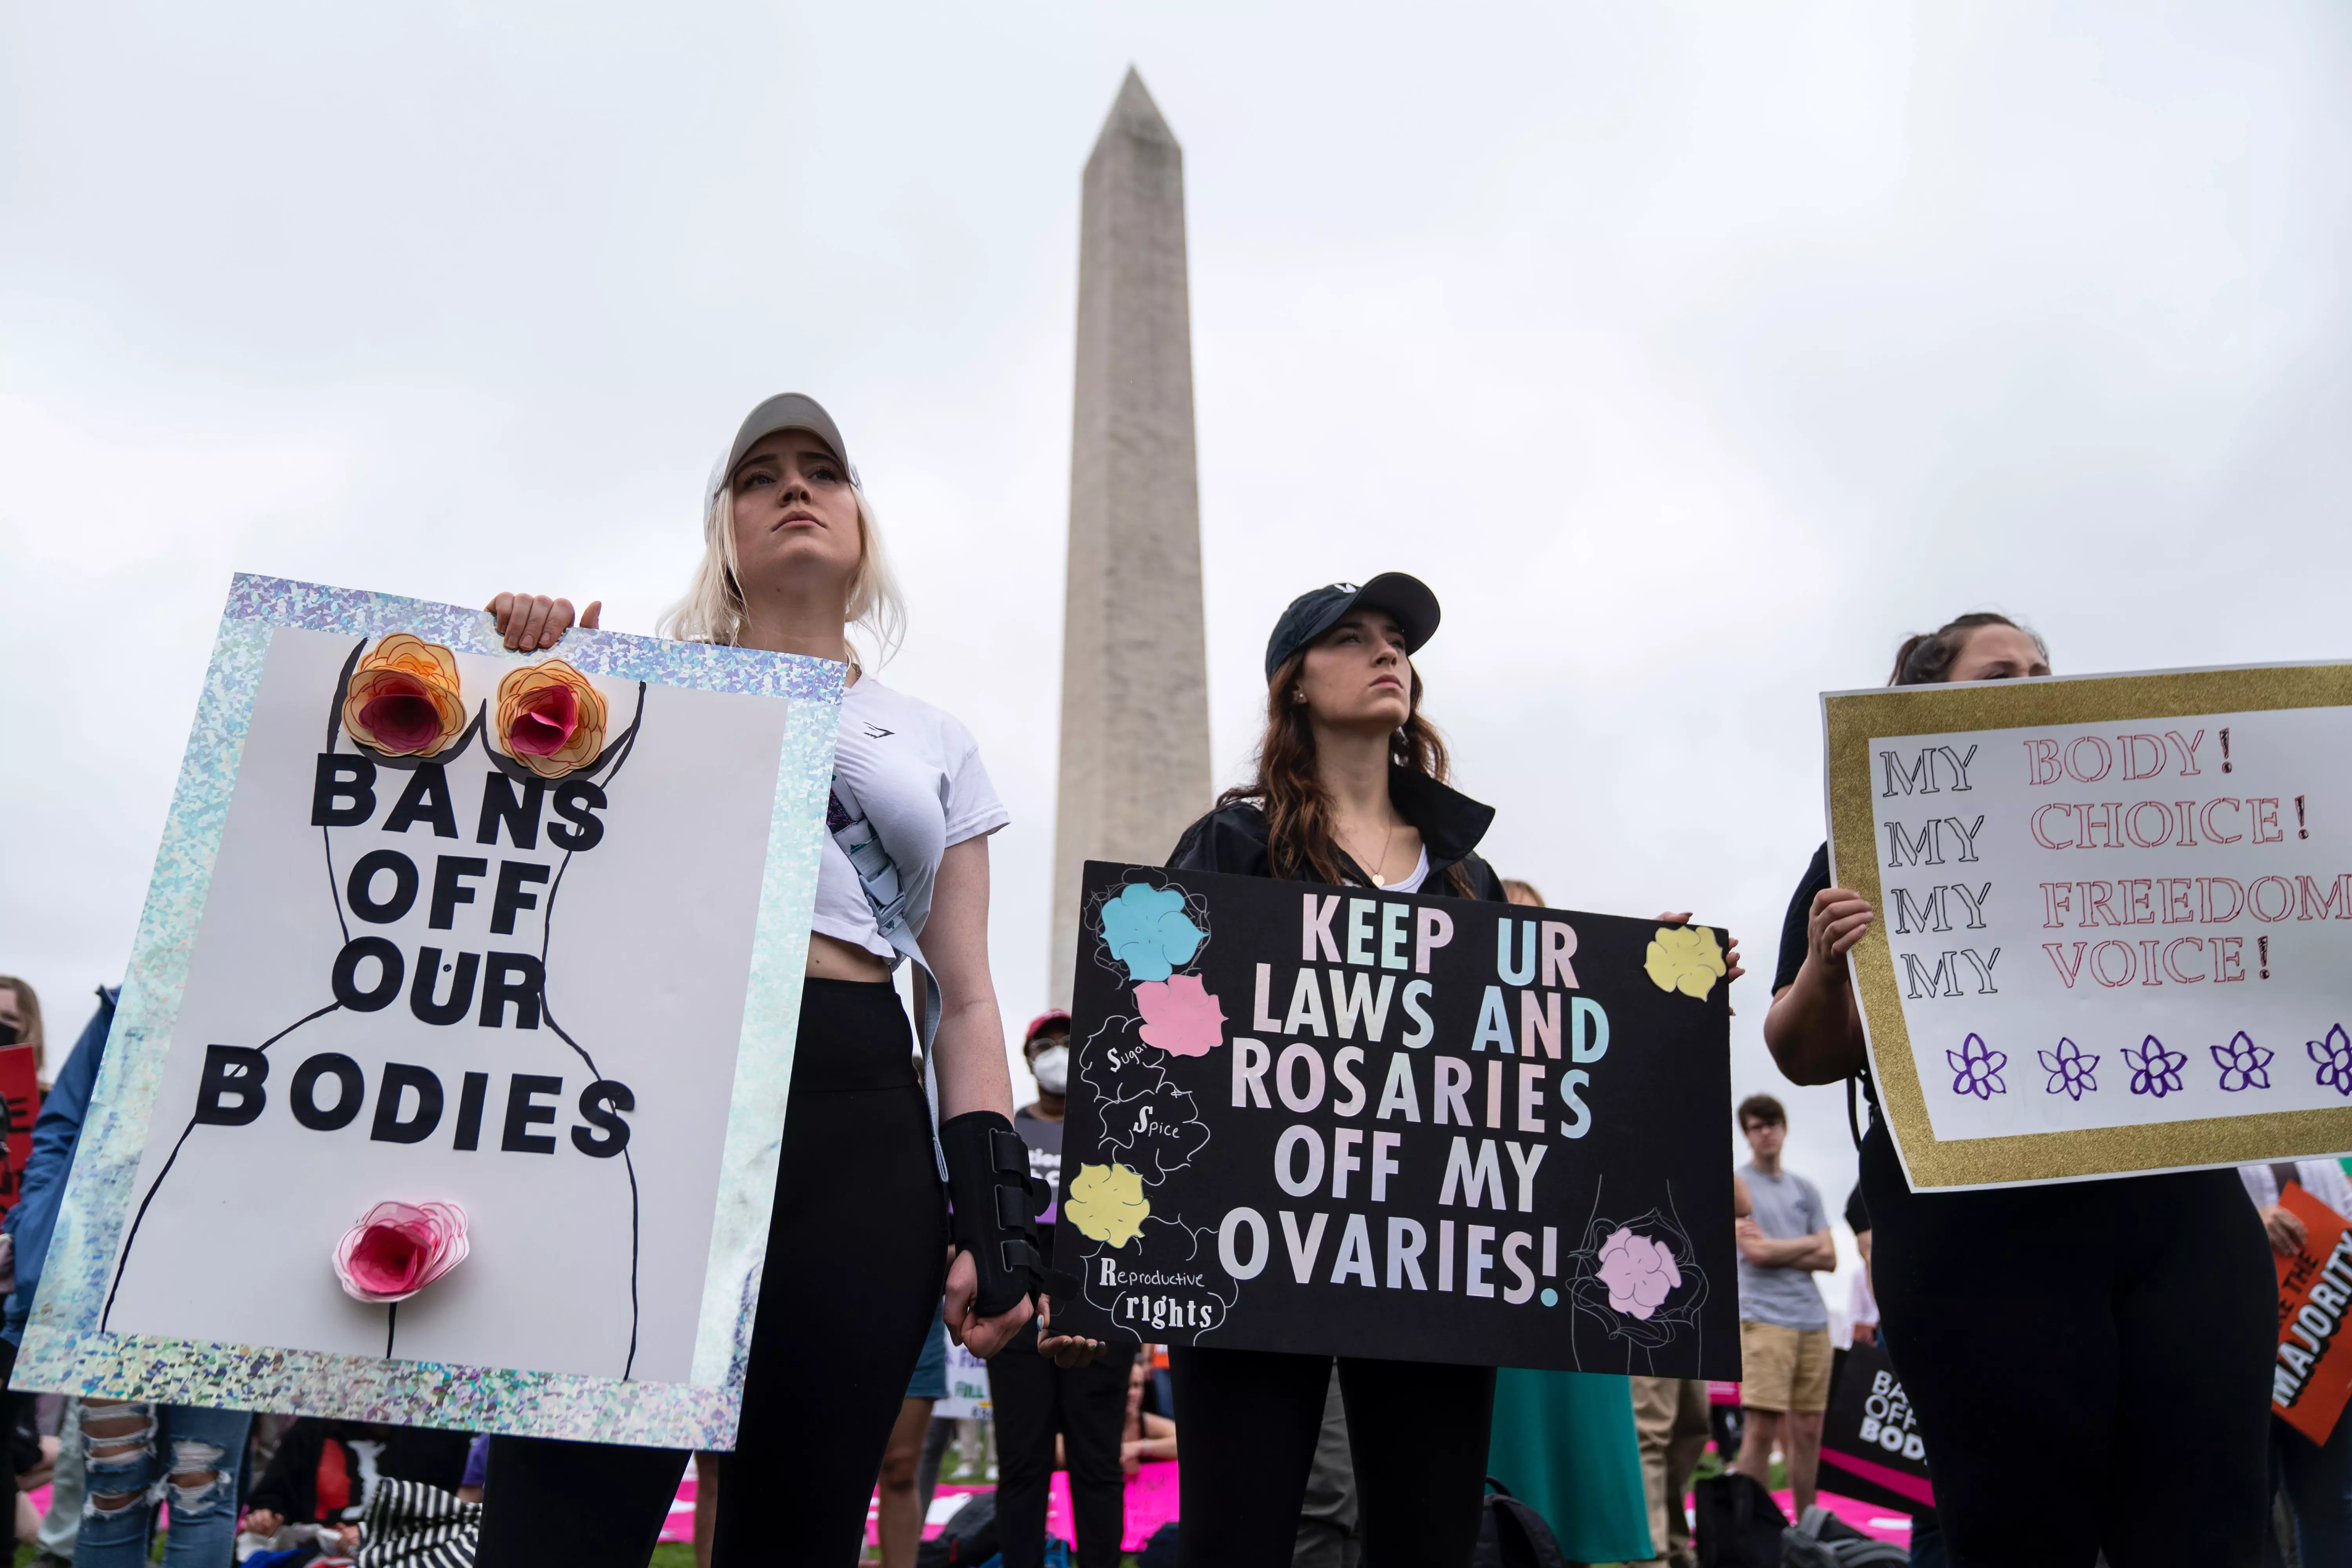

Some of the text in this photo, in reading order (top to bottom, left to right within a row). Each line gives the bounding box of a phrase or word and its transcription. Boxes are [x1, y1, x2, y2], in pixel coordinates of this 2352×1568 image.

[1881, 727, 2232, 797] MY BODY!
[311, 752, 608, 852] BANS
[1884, 795, 2309, 867] MY CHOICE!
[347, 849, 551, 935] OFF
[1891, 873, 2352, 935] MY FREEDOM
[1302, 893, 1580, 989] KEEP UR
[1900, 935, 2270, 999] MY VOICE!
[331, 936, 546, 1030] OUR
[1253, 962, 1610, 1063] LAWS AND
[1107, 1042, 1148, 1073] Sugar
[1232, 1037, 1592, 1139] ROSARIES
[195, 1044, 635, 1158] BODIES
[1132, 1105, 1180, 1138] Spice
[1274, 1124, 1548, 1212] OFF MY
[1099, 1258, 1205, 1287] Reproductive
[1218, 1206, 1559, 1307] OVARIES!
[2281, 1249, 2319, 1294] THE
[1126, 1295, 1212, 1330] rights
[1858, 1415, 1928, 1466] BOD
